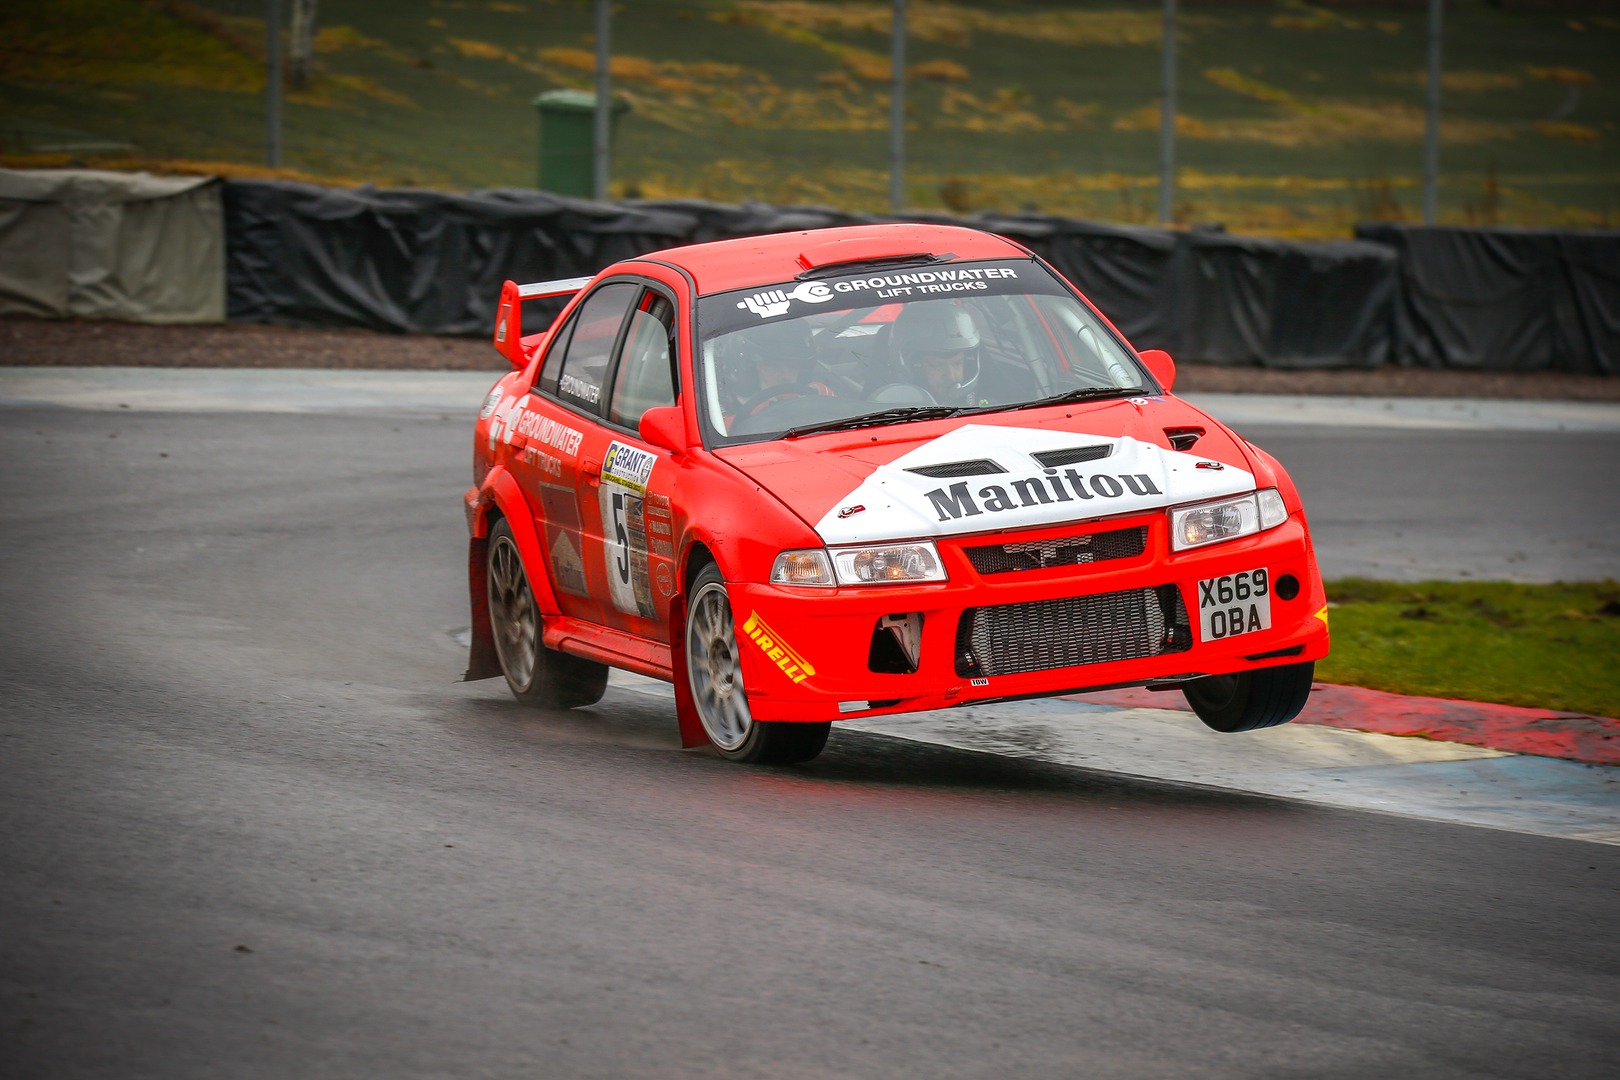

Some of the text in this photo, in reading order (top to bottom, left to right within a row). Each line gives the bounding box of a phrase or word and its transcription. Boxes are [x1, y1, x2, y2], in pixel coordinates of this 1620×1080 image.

[834, 268, 1018, 294] GROUNDWATER
[876, 281, 988, 299] LIFT TRUCKS
[518, 409, 584, 457] GROUNDWATER
[523, 444, 562, 478] LIFT TRUCKS
[615, 446, 647, 474] GRANT
[924, 468, 1163, 523] Manitou
[612, 492, 630, 585] 5
[1199, 568, 1269, 609] X669
[1210, 603, 1263, 639] OBA
[743, 609, 816, 685] PIRELLI
